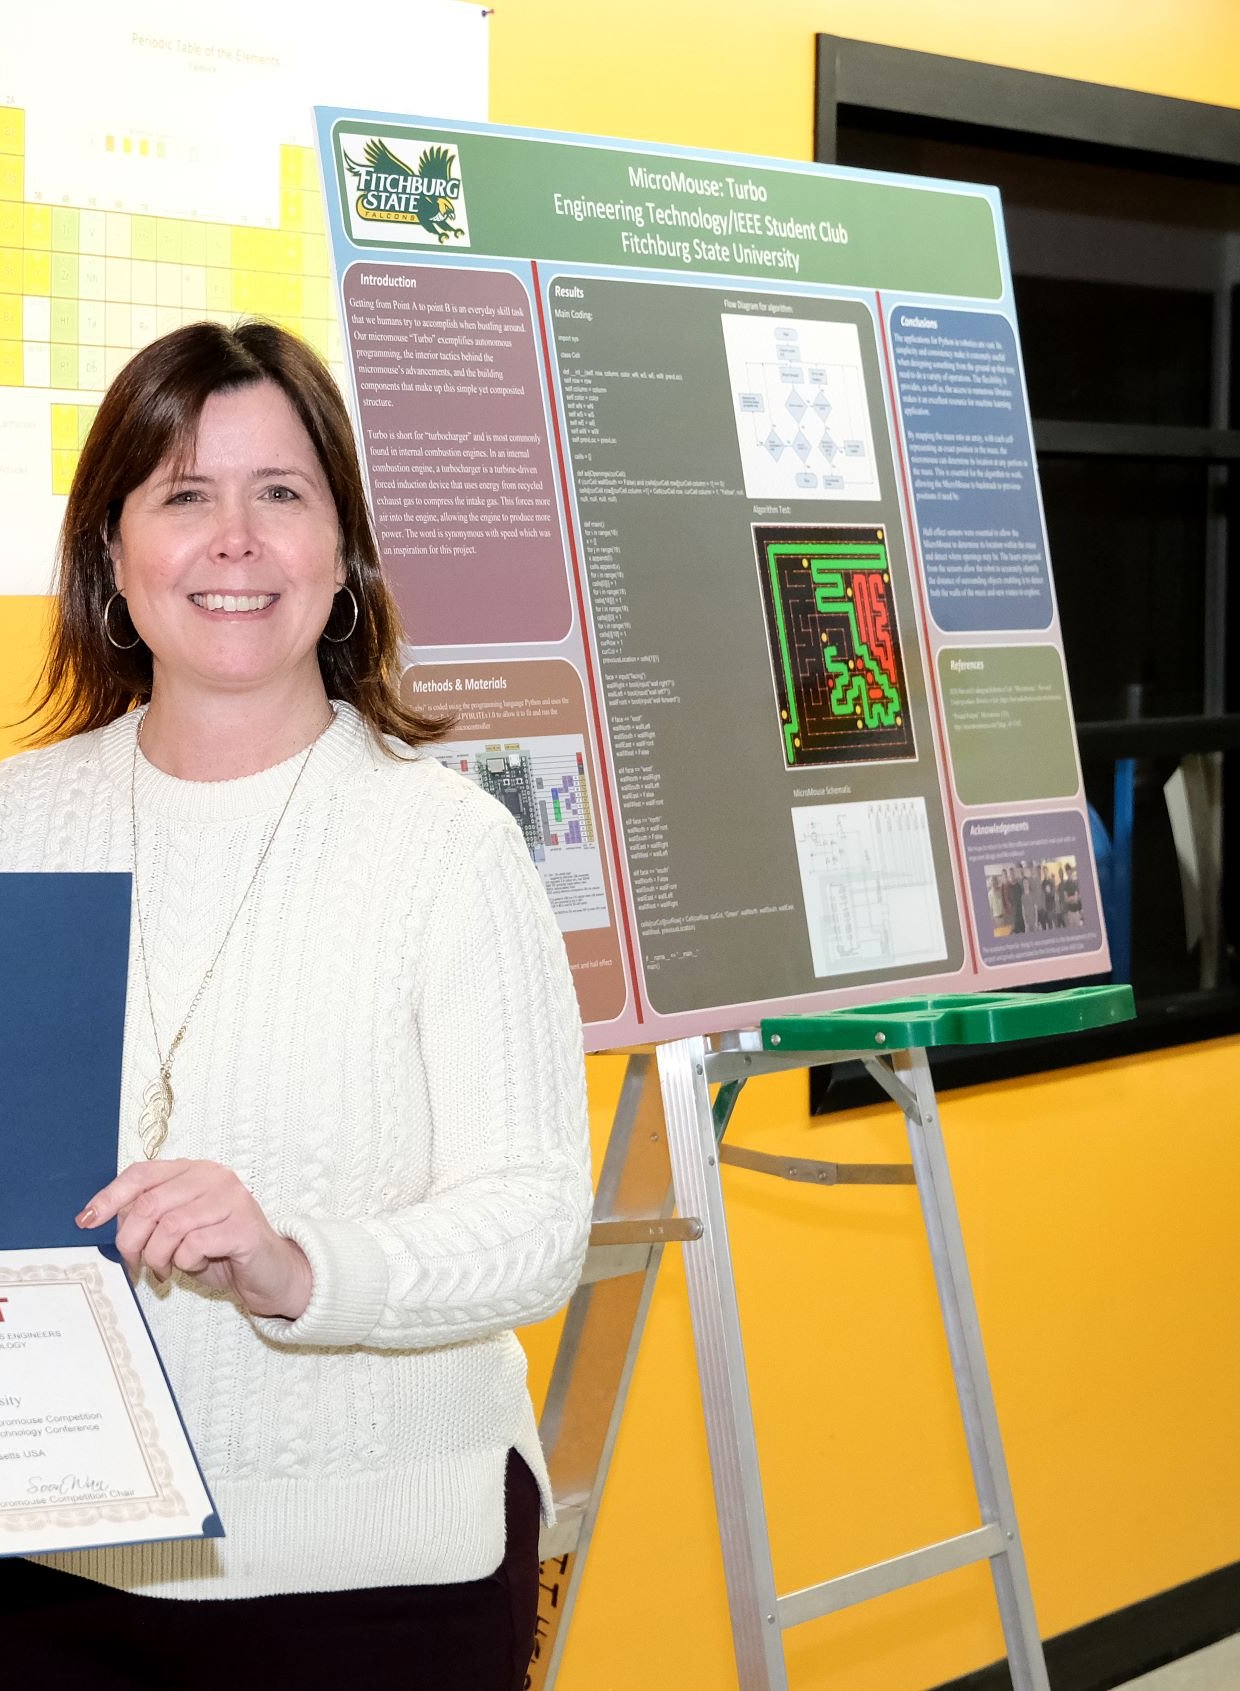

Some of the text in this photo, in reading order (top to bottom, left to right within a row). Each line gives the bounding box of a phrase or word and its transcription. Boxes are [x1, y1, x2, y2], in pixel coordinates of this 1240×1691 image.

[132, 32, 280, 66] Periodic Table of the Elements
[358, 167, 460, 198] FITCHBURG
[629, 166, 766, 202] MicroMouse: Turbo
[364, 192, 420, 213] STATE
[365, 211, 416, 221] FALCONS
[554, 194, 848, 243] Engineering Technology/IEEE Student Club
[622, 232, 799, 274] Fitchburg State University
[360, 274, 416, 288] Introduction
[555, 286, 584, 298] Results
[349, 298, 374, 311] Getting
[375, 300, 391, 309] from
[393, 301, 410, 310] Point
[411, 302, 417, 311] A
[418, 303, 426, 311] to
[426, 303, 443, 314] point
[444, 303, 450, 313] B
[451, 304, 457, 313] is
[467, 306, 495, 317] everyday
[496, 306, 510, 316] skill
[511, 307, 524, 317] task
[555, 309, 592, 321] Main Coding:
[352, 315, 364, 324] that
[377, 316, 402, 326] humans
[403, 318, 412, 329] try
[414, 319, 421, 327] to
[422, 319, 458, 331] accomplish
[459, 320, 476, 330] when
[477, 321, 502, 333] bustling
[503, 323, 526, 332] around.
[901, 316, 937, 329] Conclusions
[353, 331, 367, 340] Our
[368, 332, 408, 342] micromouse
[437, 336, 474, 347] exemplifies
[474, 338, 512, 347] autonomous
[356, 349, 493, 362] programming, the interior tactics behind the
[405, 366, 452, 378] advancements,
[453, 368, 465, 377] and
[466, 368, 476, 378] the
[477, 369, 503, 381] building
[361, 382, 524, 397] components that make up this simple yet composited
[363, 398, 394, 407] structure.
[368, 430, 388, 439] Turbo
[389, 430, 395, 439] is
[396, 430, 413, 439] short
[414, 431, 424, 440] for
[472, 432, 485, 441] and
[485, 432, 492, 441] is
[492, 433, 508, 441] most
[508, 433, 541, 444] commonly
[753, 505, 791, 515] Algorithm Test:
[951, 660, 984, 670] References
[413, 677, 507, 692] Methods & Materials
[794, 786, 851, 797] MicroMouse Schematic
[970, 822, 1029, 835] Acknowledgements
[7, 1330, 62, 1340] ENGINEERS
[45, 1412, 102, 1423] Competition
[45, 1425, 100, 1434] Conference
[23, 1449, 46, 1458] USA
[49, 1492, 107, 1503] Competition
[109, 1489, 135, 1497] Chair
